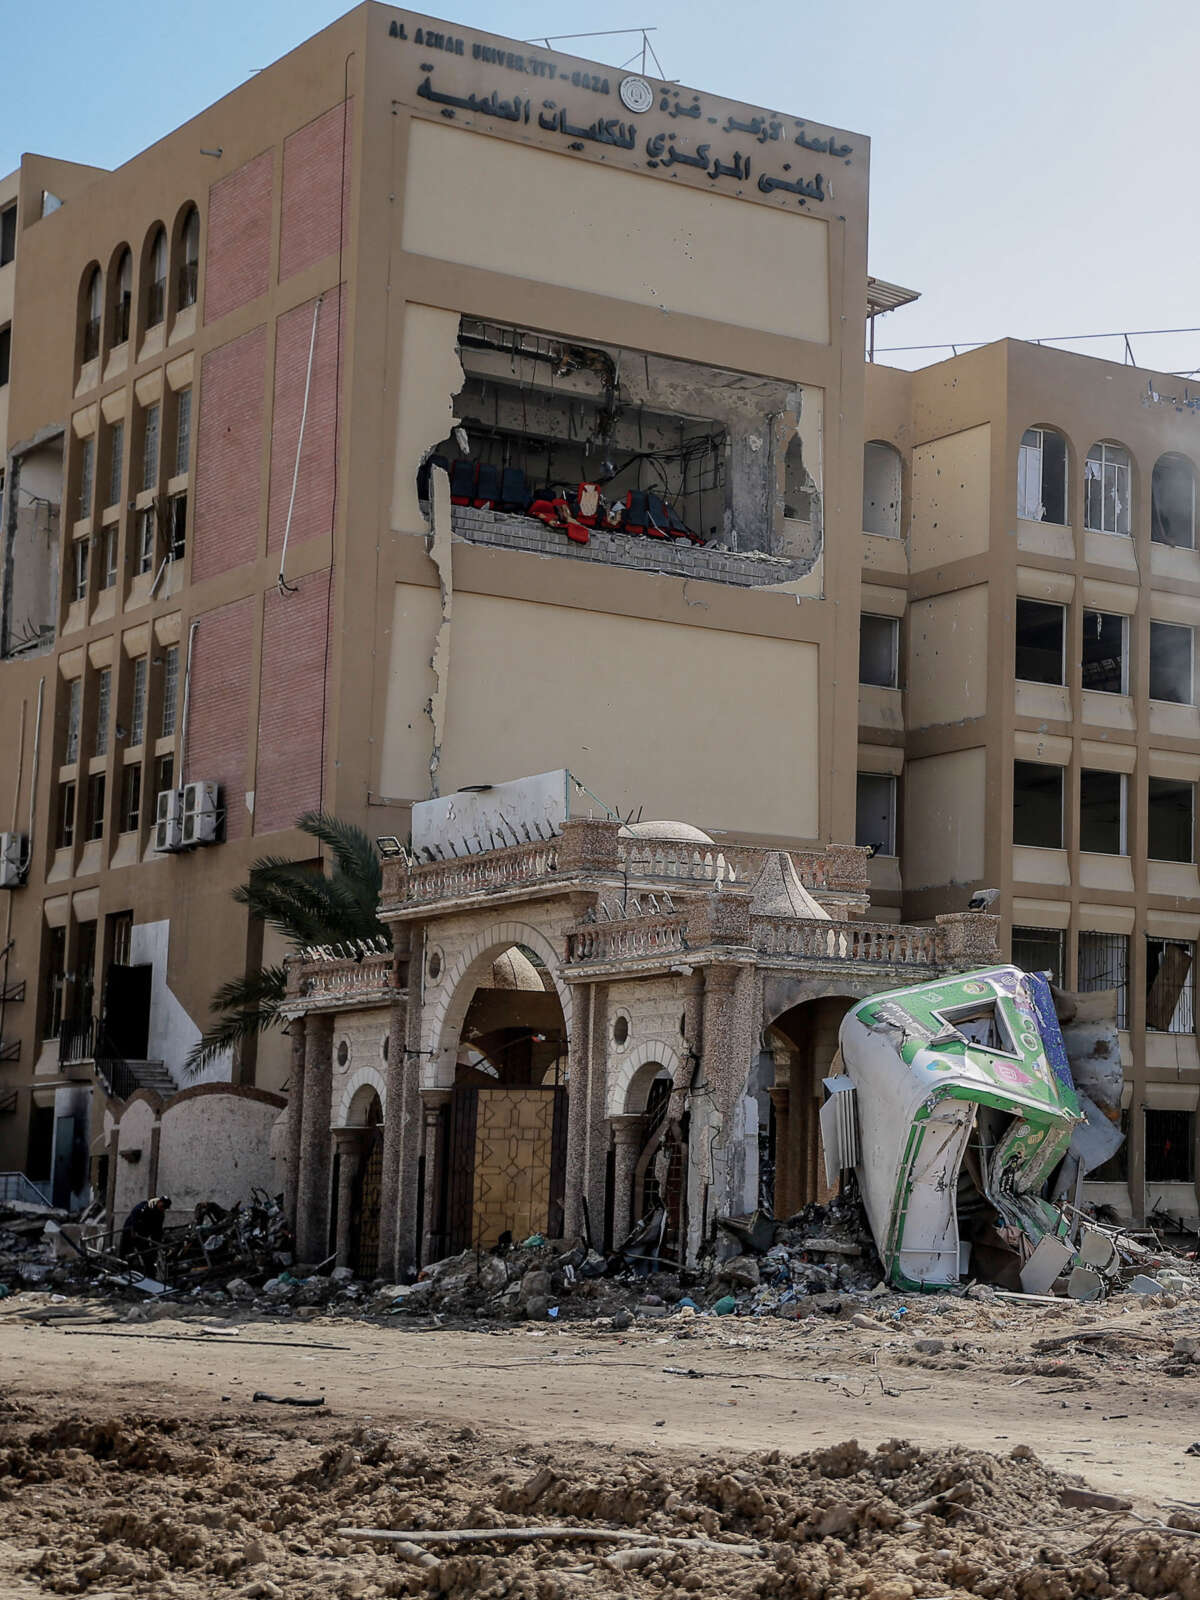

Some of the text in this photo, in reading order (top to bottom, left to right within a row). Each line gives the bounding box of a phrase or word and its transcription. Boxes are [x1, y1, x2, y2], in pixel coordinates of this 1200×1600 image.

[389, 20, 408, 40] AL
[414, 28, 464, 56] AZHAR
[571, 71, 610, 95] GAZA
[416, 62, 530, 125] العلمية
[659, 87, 701, 118] غزة
[538, 99, 637, 150] للكليات
[793, 119, 853, 166] جامعة
[646, 132, 751, 181] المركزي
